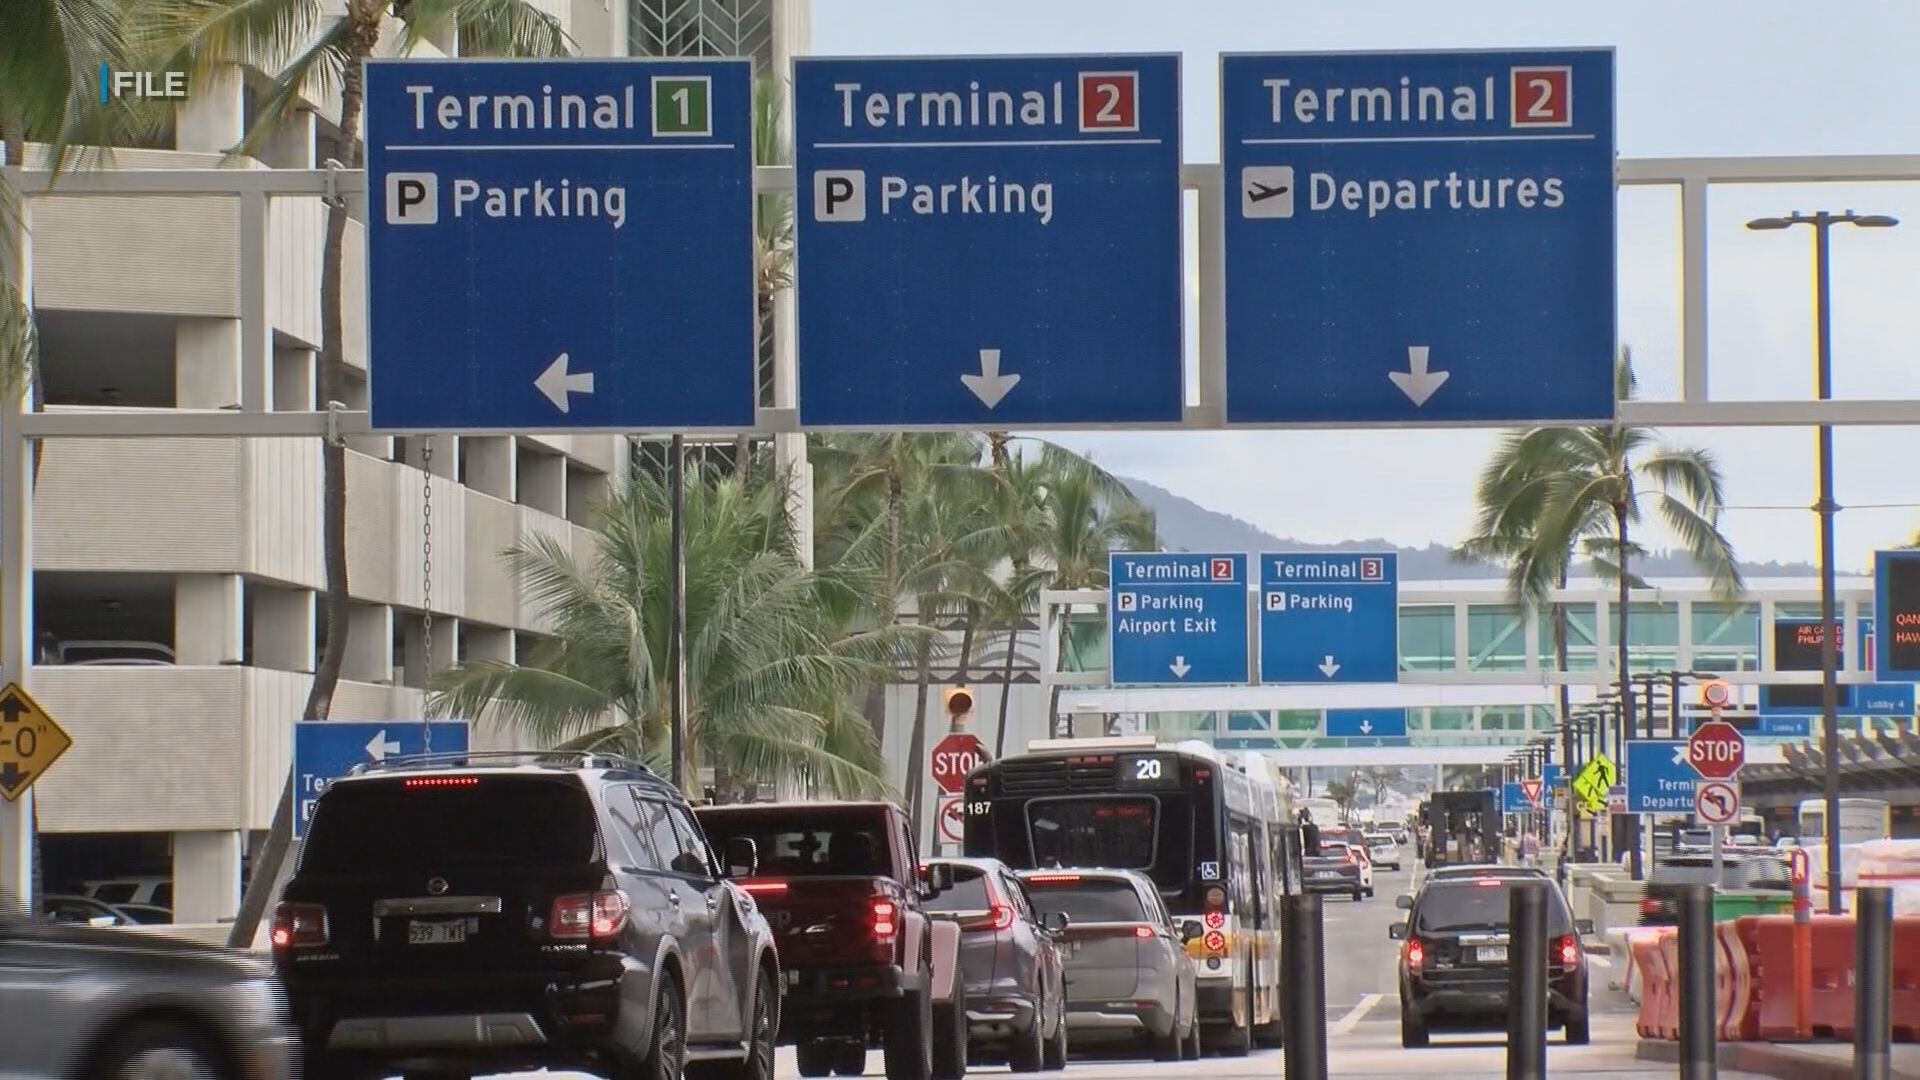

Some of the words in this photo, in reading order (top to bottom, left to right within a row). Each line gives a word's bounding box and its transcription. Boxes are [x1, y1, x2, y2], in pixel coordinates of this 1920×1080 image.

[407, 84, 634, 130] Terminal
[671, 87, 689, 125] 1
[834, 81, 1062, 127] Terminal
[1096, 83, 1121, 122] 2
[1263, 76, 1494, 123] Terminal
[1528, 79, 1554, 117] 2
[397, 179, 426, 217] P
[454, 178, 626, 230] Parking
[825, 177, 854, 215] P
[881, 175, 1053, 225] Parking
[1310, 171, 1565, 218] Departures
[1125, 561, 1207, 579] Terminal
[1217, 562, 1227, 577] 2
[1274, 560, 1356, 578] Terminal
[1367, 561, 1377, 576] 3
[1121, 594, 1133, 609] P
[1141, 594, 1203, 613] Parking
[1270, 594, 1282, 609] P
[1290, 594, 1353, 613] Parking
[1118, 618, 1176, 636] Airport
[1184, 617, 1217, 633] Exit
[1867, 700, 1893, 710] Lobby
[1692, 740, 1742, 761] STOP
[1136, 759, 1161, 780] 20
[967, 801, 992, 815] 187
[1642, 795, 1694, 809] Departu
